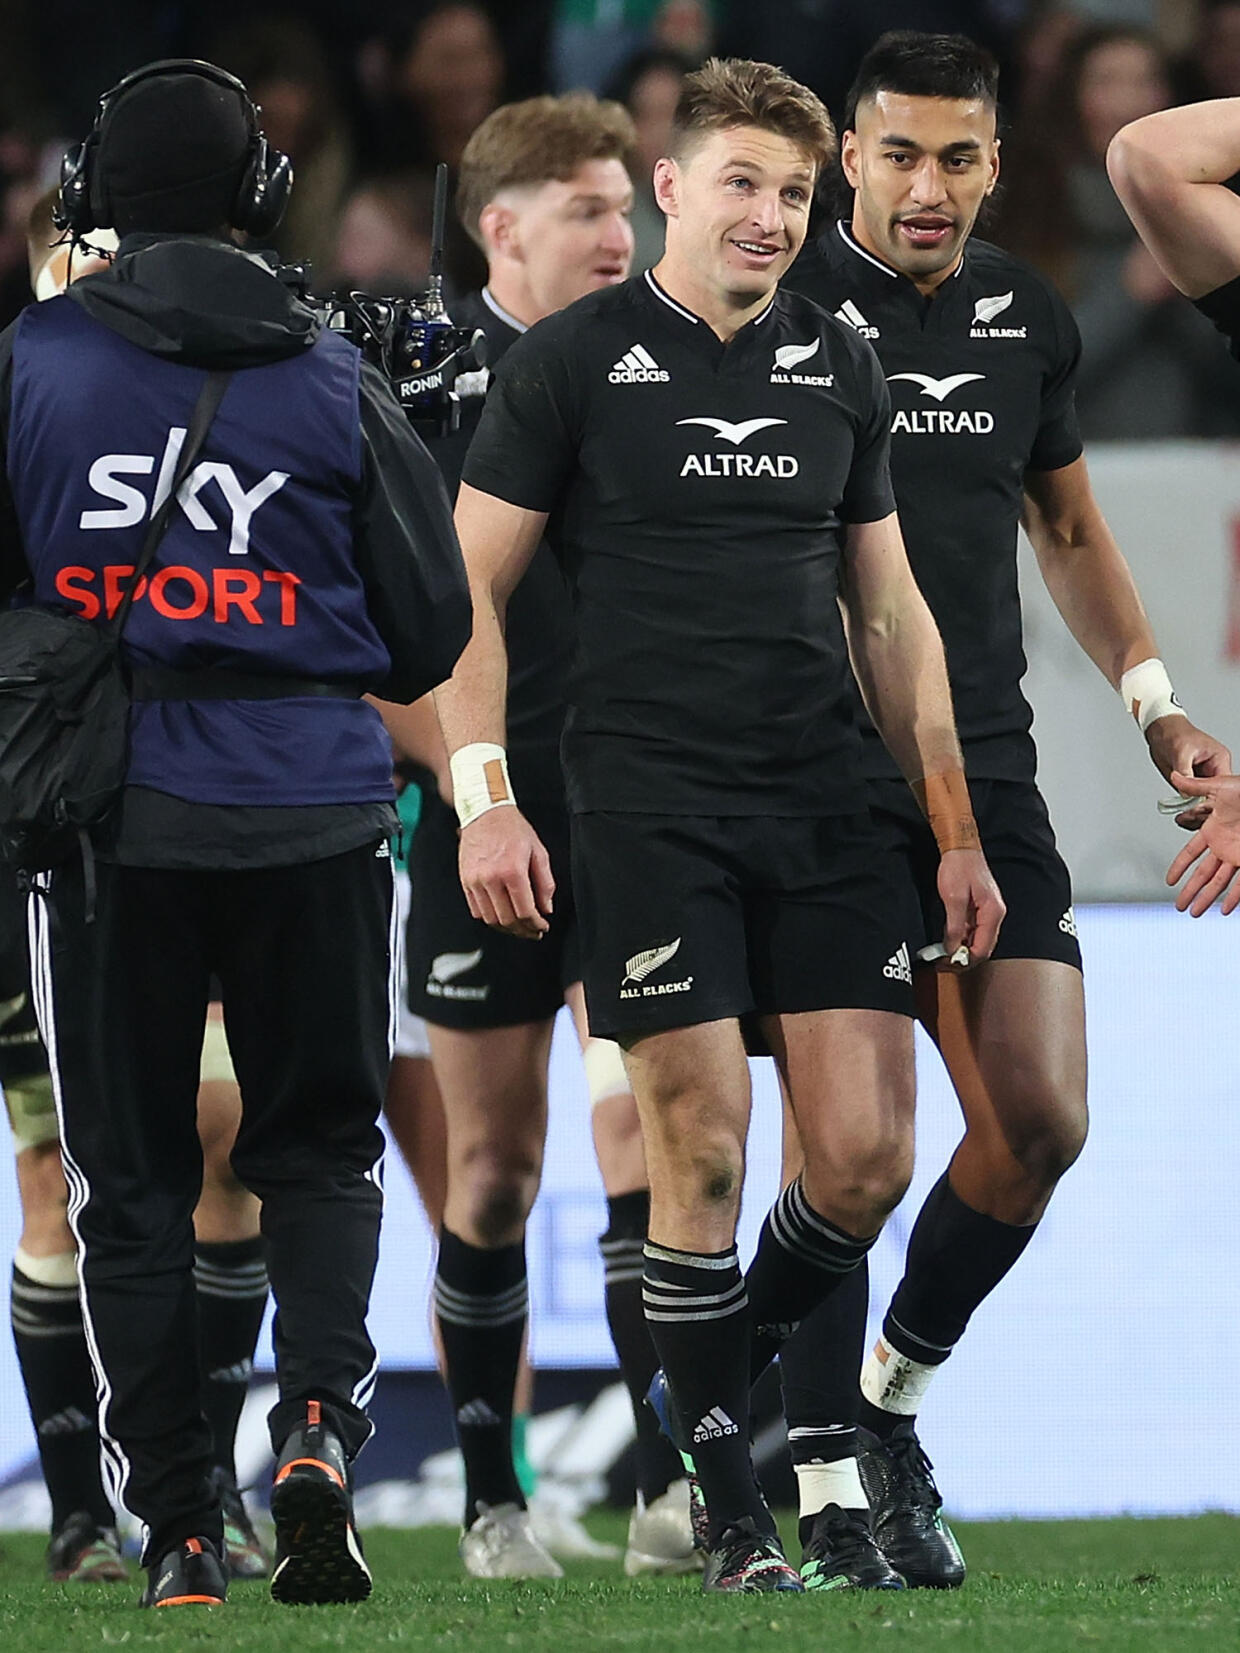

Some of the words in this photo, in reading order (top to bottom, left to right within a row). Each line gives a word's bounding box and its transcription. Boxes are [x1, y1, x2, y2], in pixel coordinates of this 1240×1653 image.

[970, 328, 988, 338] ALL
[989, 328, 1027, 338] BLACKS
[400, 372, 443, 397] RONIN
[608, 368, 670, 384] adidas
[770, 373, 791, 384] ALL
[791, 374, 833, 387] BLACKS
[890, 410, 995, 434] ALTRAD
[680, 454, 799, 478] ALTRAD
[55, 565, 302, 626] SPORT
[620, 988, 641, 999] ALL
[642, 980, 691, 996] BLACKS
[693, 1423, 739, 1443] adidas
